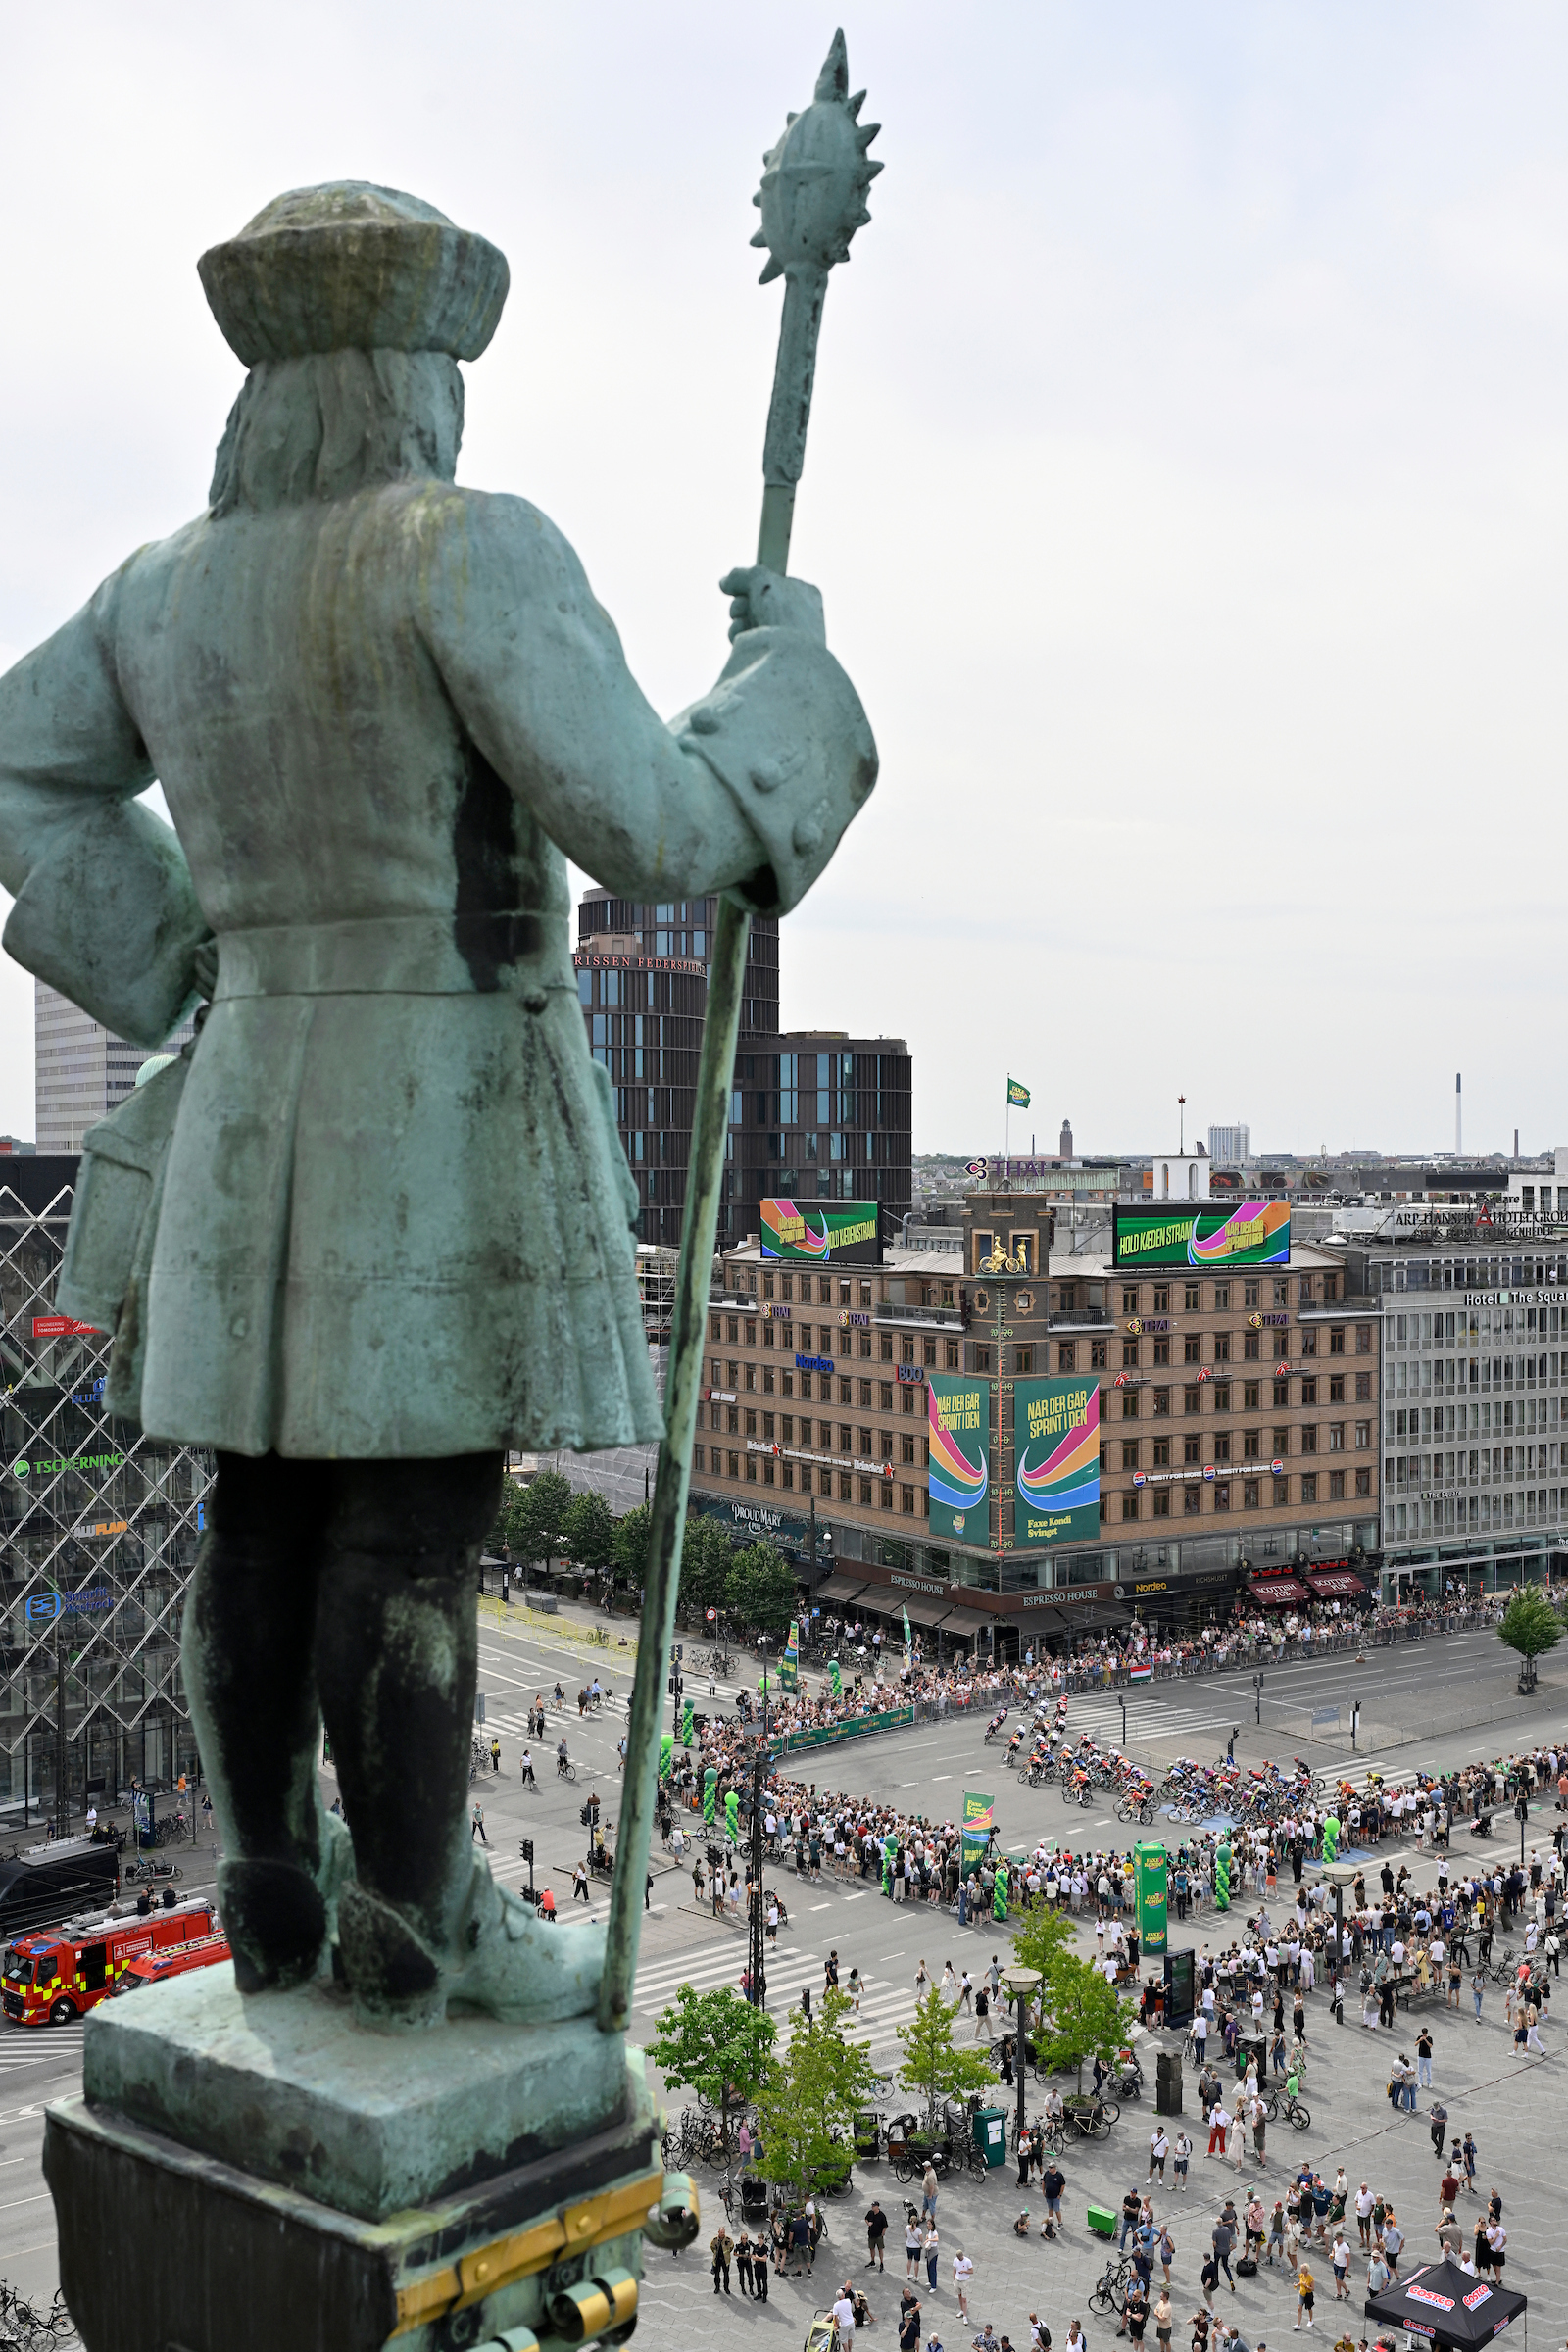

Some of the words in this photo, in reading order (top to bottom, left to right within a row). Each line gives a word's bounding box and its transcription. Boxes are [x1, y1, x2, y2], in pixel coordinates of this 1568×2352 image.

[992, 1160, 1046, 1177] THAI
[858, 1219, 876, 1243] STRAM
[1119, 1234, 1140, 1257] HOLD
[1140, 1226, 1165, 1251] KÆDEN
[1166, 1221, 1193, 1245] STRAM
[1466, 1292, 1498, 1306] Hotel
[1511, 1291, 1533, 1304] The
[771, 1305, 790, 1319] THAI
[849, 1312, 869, 1326] THAI
[1264, 1314, 1289, 1326] THAI
[1143, 1319, 1170, 1332] THAI
[796, 1354, 834, 1372] Nordea
[898, 1365, 923, 1383] BDO
[991, 1382, 998, 1391] 10
[1004, 1382, 1013, 1391] 10
[936, 1396, 952, 1414] NÅR
[952, 1395, 964, 1412] DER
[965, 1392, 980, 1410] GÅR
[1027, 1400, 1049, 1421] NÅR
[1049, 1396, 1067, 1418] DER
[1067, 1390, 1088, 1412] GÅR
[937, 1413, 962, 1432] SPRINT
[965, 1411, 980, 1429] DEN
[1030, 1416, 1064, 1440] SPRINT
[1068, 1408, 1088, 1430] DEN
[33, 1452, 124, 1475] TSCHERNING
[1441, 1490, 1462, 1499] Square
[732, 1503, 760, 1523] PROUD
[760, 1509, 782, 1528] MARY
[1028, 1518, 1049, 1529] Faxe
[1049, 1515, 1071, 1526] Kondi
[74, 1520, 128, 1539] ALUFLAM
[752, 1521, 760, 1531] PUB
[1028, 1527, 1058, 1539] Svinget
[891, 1574, 920, 1590] ESPRESSO
[921, 1581, 944, 1595] HOUSE
[1135, 1582, 1166, 1592] Nordea
[1196, 1574, 1228, 1584] RICHSHUSET
[1314, 1576, 1353, 1587] SCOTTISH
[65, 1586, 107, 1602] Smurfit
[1256, 1583, 1297, 1594] SCOTTISH
[1273, 1590, 1291, 1598] PUB
[66, 1596, 114, 1613] Westrock
[1023, 1592, 1066, 1607] ESPRESSO
[1067, 1589, 1098, 1601] HOUSE
[1409, 2285, 1454, 2307] COSTCO
[1463, 2284, 1489, 2306] COSTCO
[1403, 2319, 1435, 2334] COSTCO
